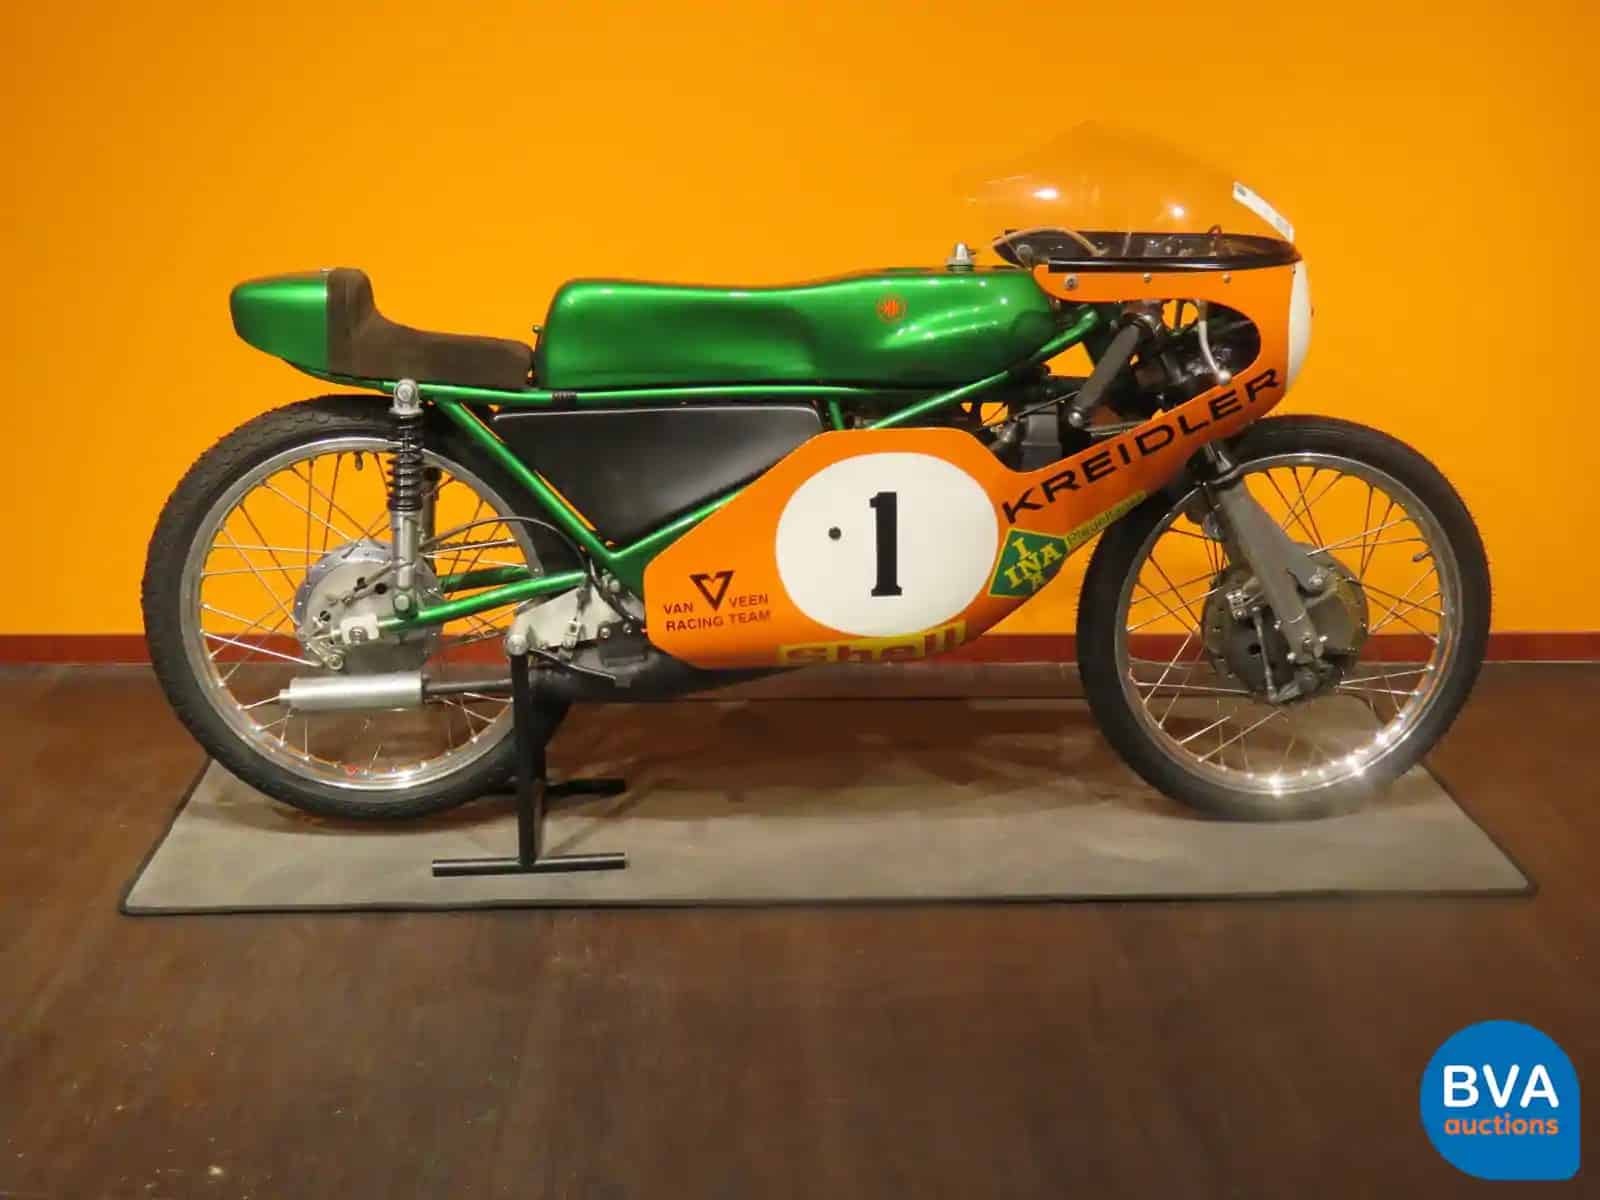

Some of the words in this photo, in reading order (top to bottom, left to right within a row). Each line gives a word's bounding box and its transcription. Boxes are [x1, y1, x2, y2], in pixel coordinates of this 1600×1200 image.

[1002, 368, 1280, 524] KREIDLER
[869, 491, 903, 597] 1
[663, 602, 694, 615] VAN
[729, 593, 769, 608] VEEN
[665, 616, 724, 632] RACING
[728, 610, 771, 625] TEAM
[786, 627, 956, 664] Shell
